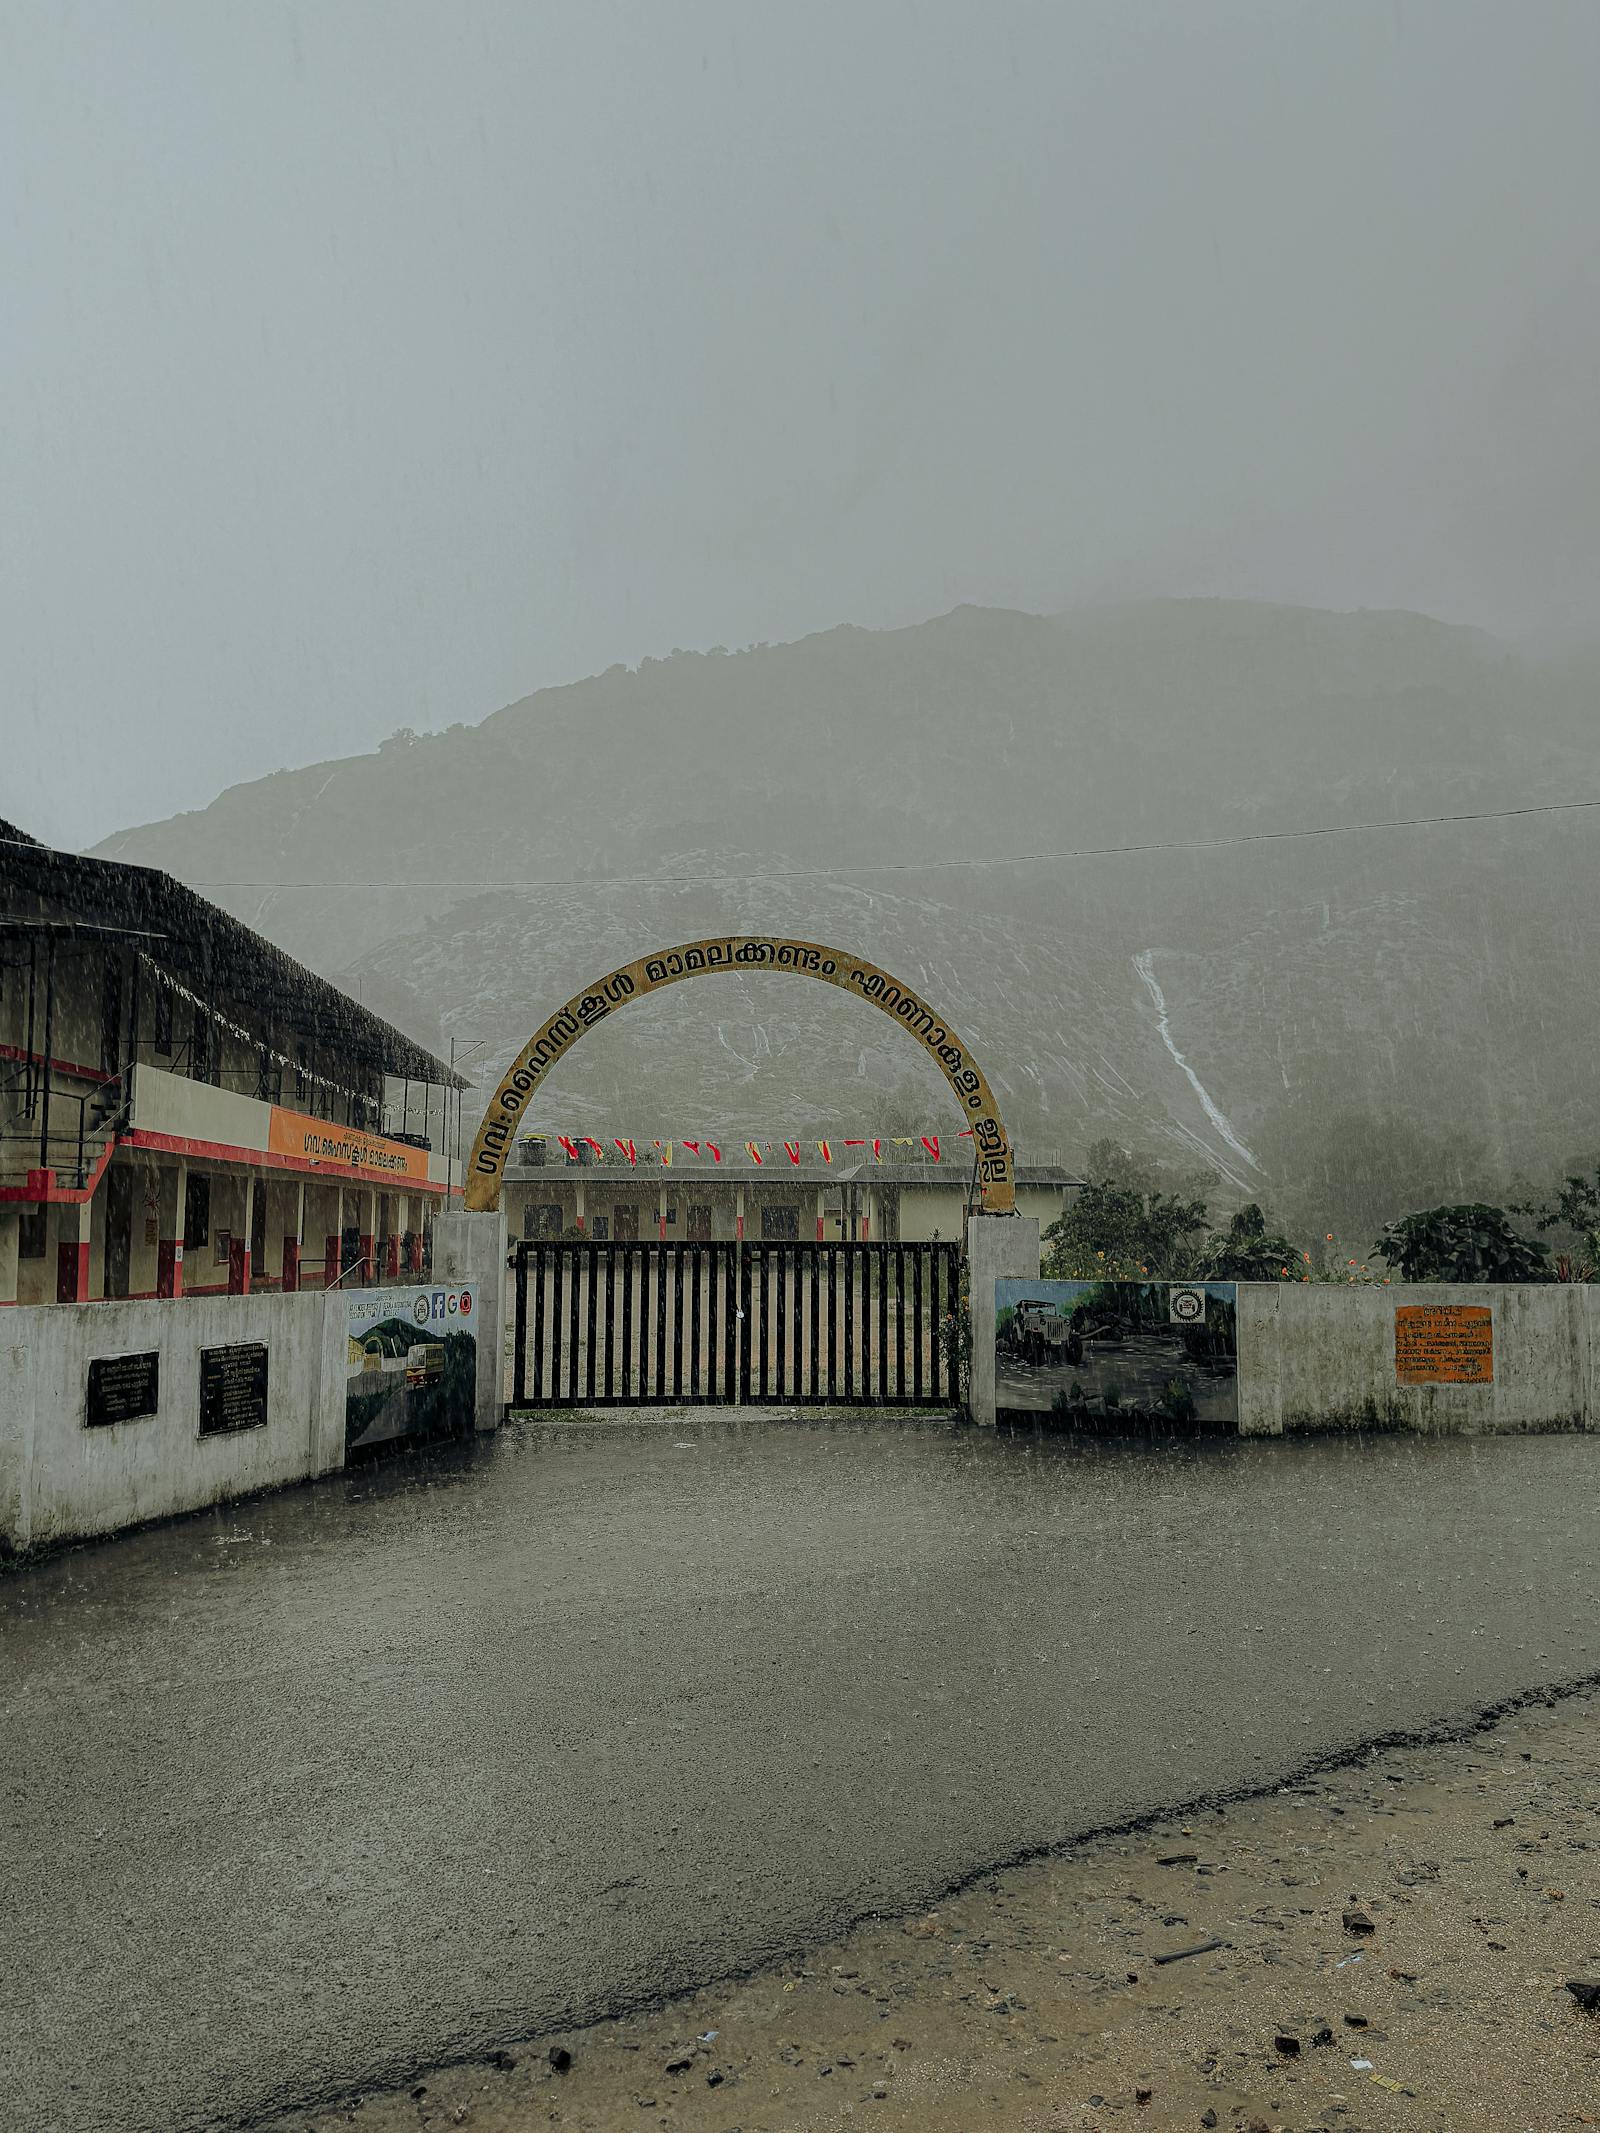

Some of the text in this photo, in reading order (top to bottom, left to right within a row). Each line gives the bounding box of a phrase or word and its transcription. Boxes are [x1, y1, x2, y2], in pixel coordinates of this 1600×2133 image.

[645, 942, 837, 983] മാമലക്കണ്ടം
[850, 970, 983, 1109] എറണാകുളം
[974, 1118, 1008, 1183] ജില്ല
[448, 1294, 458, 1314] G
